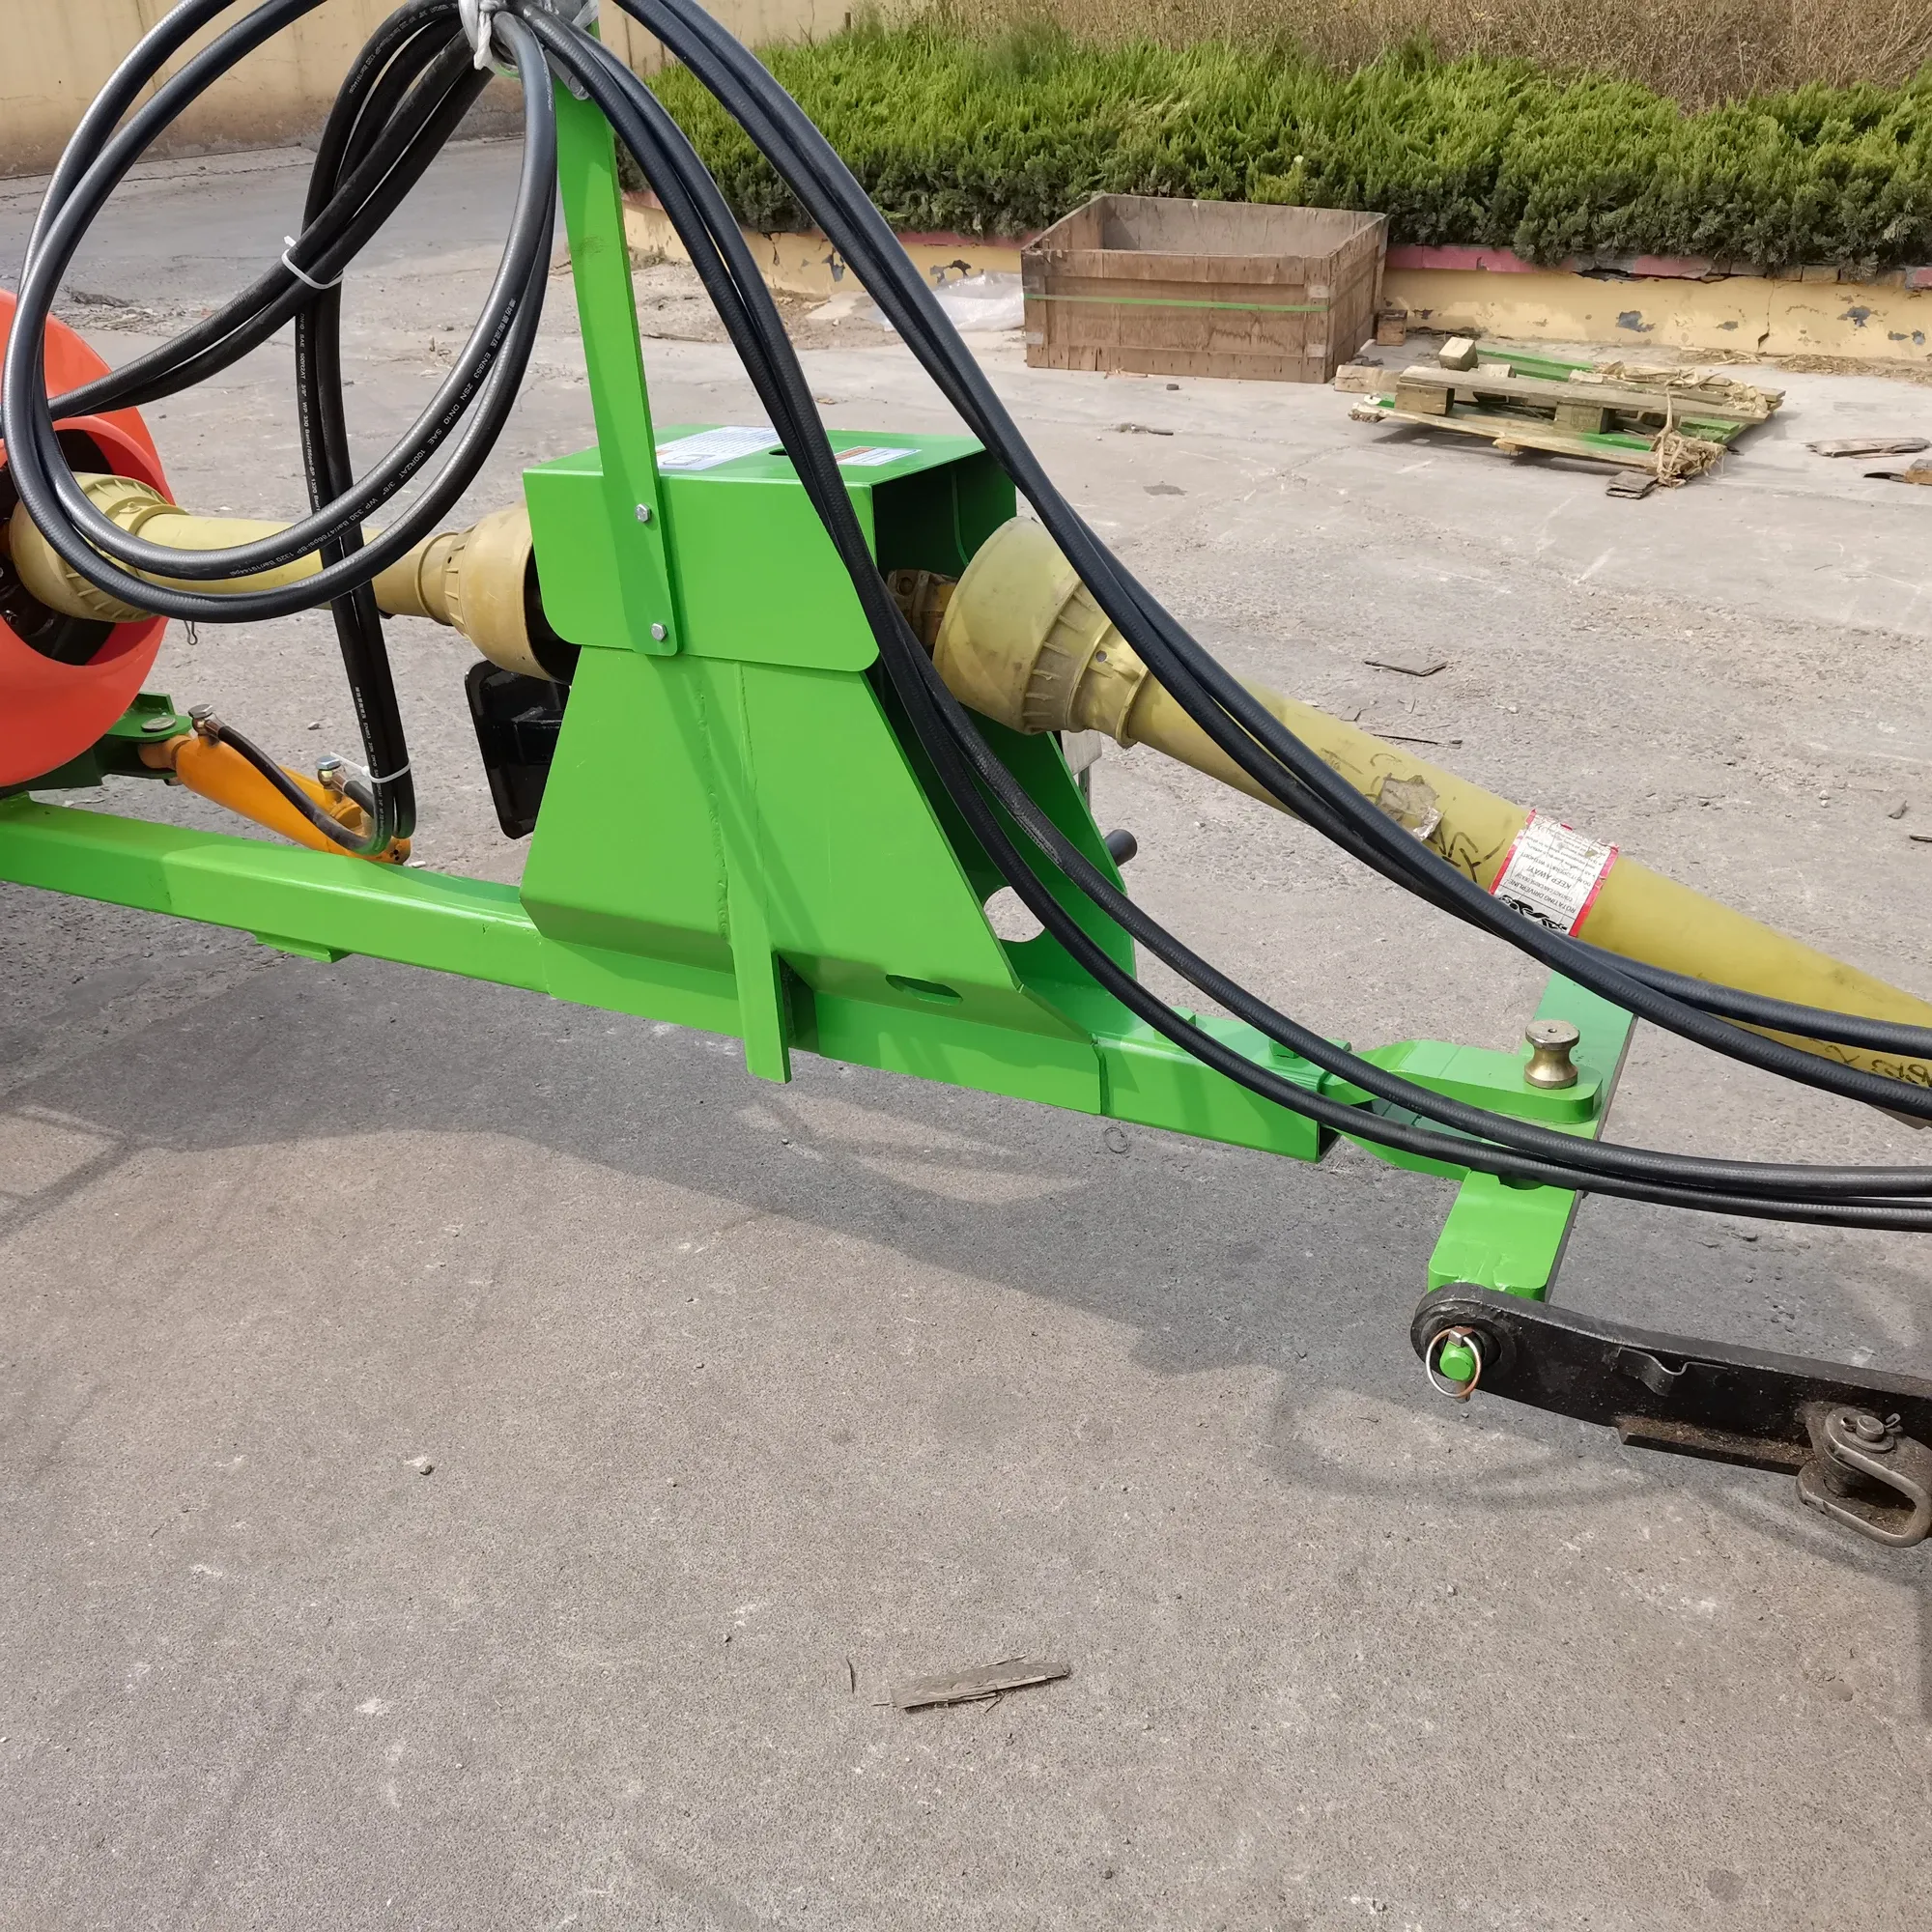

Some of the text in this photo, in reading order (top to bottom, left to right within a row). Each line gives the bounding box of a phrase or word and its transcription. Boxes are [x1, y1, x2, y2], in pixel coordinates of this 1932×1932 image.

[460, 383, 473, 401] 2SN
[443, 404, 460, 425] DN10
[427, 428, 442, 444] SAE
[398, 449, 426, 479] 100R2AT
[365, 497, 378, 510] WP
[349, 508, 364, 522] 330
[275, 552, 295, 563] 1320
[1550, 876, 1572, 889] KEEP
[1552, 890, 1573, 901] CONTACT
[1543, 895, 1576, 913] ROTATING
